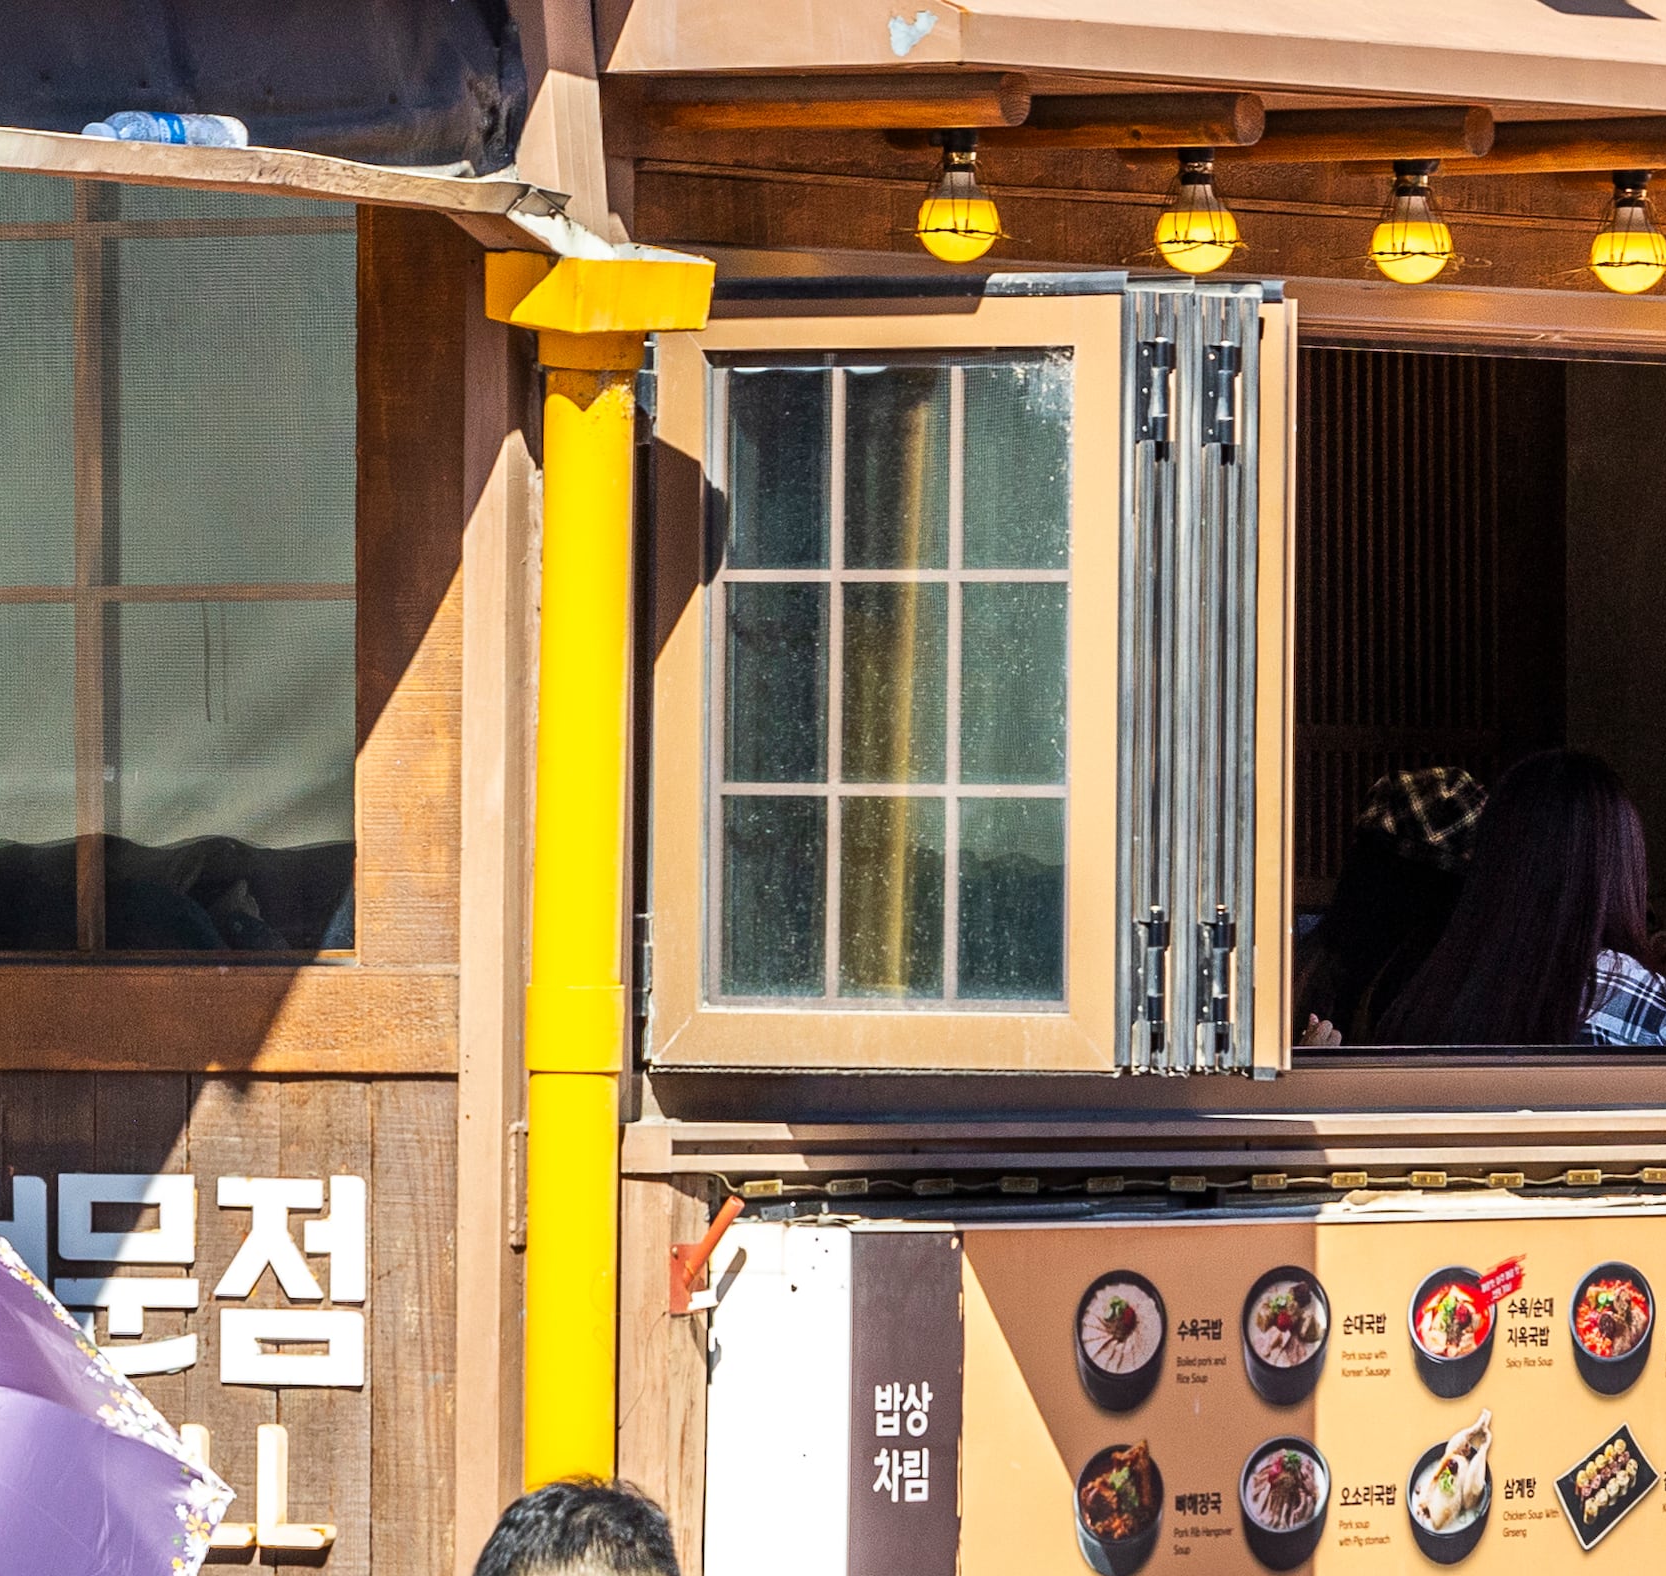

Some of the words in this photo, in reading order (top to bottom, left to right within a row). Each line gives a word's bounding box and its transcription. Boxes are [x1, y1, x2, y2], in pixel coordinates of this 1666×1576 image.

[1507, 1297, 1554, 1320] 수육/순대
[1177, 1318, 1223, 1341] 수육국밥
[1343, 1313, 1387, 1335] 순대국밥
[1507, 1326, 1550, 1348] 지옥국밥
[874, 1381, 933, 1437] 밥상
[872, 1447, 930, 1502] 차림
[1340, 1484, 1397, 1506] 오소리국밥
[1504, 1478, 1536, 1500] 삼계탕
[1503, 1511, 1527, 1521] Chicken
[1503, 1528, 1527, 1538] Ginseng
